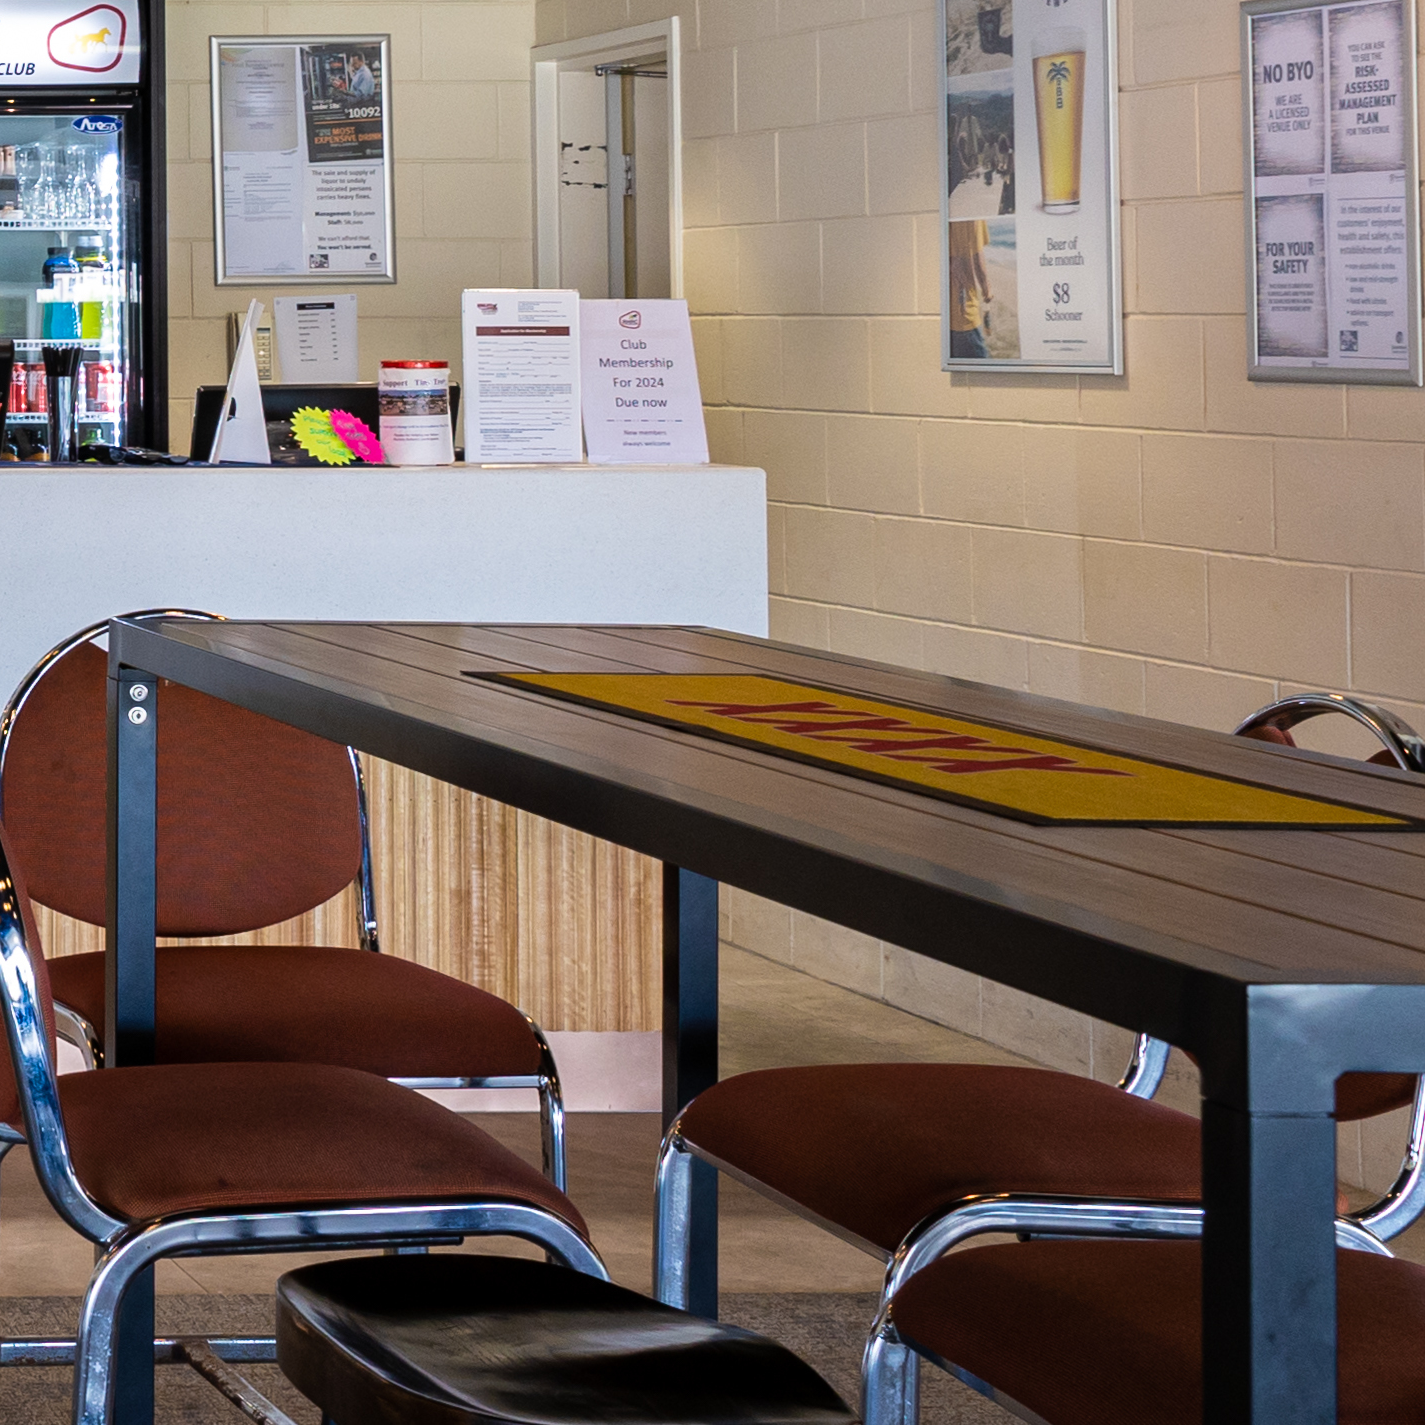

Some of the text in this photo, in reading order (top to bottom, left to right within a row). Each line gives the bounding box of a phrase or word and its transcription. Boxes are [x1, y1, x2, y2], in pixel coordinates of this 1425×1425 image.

[1263, 60, 1314, 84] NO BYO
[1345, 79, 1390, 94] ASSESSED
[1338, 94, 1397, 110] MANAGEMENT
[1275, 106, 1309, 119] LICENSED
[1356, 111, 1379, 124] PLAN
[1267, 119, 1312, 133] VENUE ONLY
[1046, 235, 1078, 251] Beer of
[1266, 241, 1315, 257] FOR YOUR
[1039, 252, 1085, 266] the month
[1272, 259, 1309, 274] SAFETY
[1052, 282, 1070, 306] $8
[1045, 309, 1083, 321] Schooner
[620, 339, 647, 350] Club
[599, 358, 674, 370] Membership
[613, 377, 665, 388] For 2024
[615, 397, 668, 408] Due now
[664, 700, 1141, 777] XXXX
